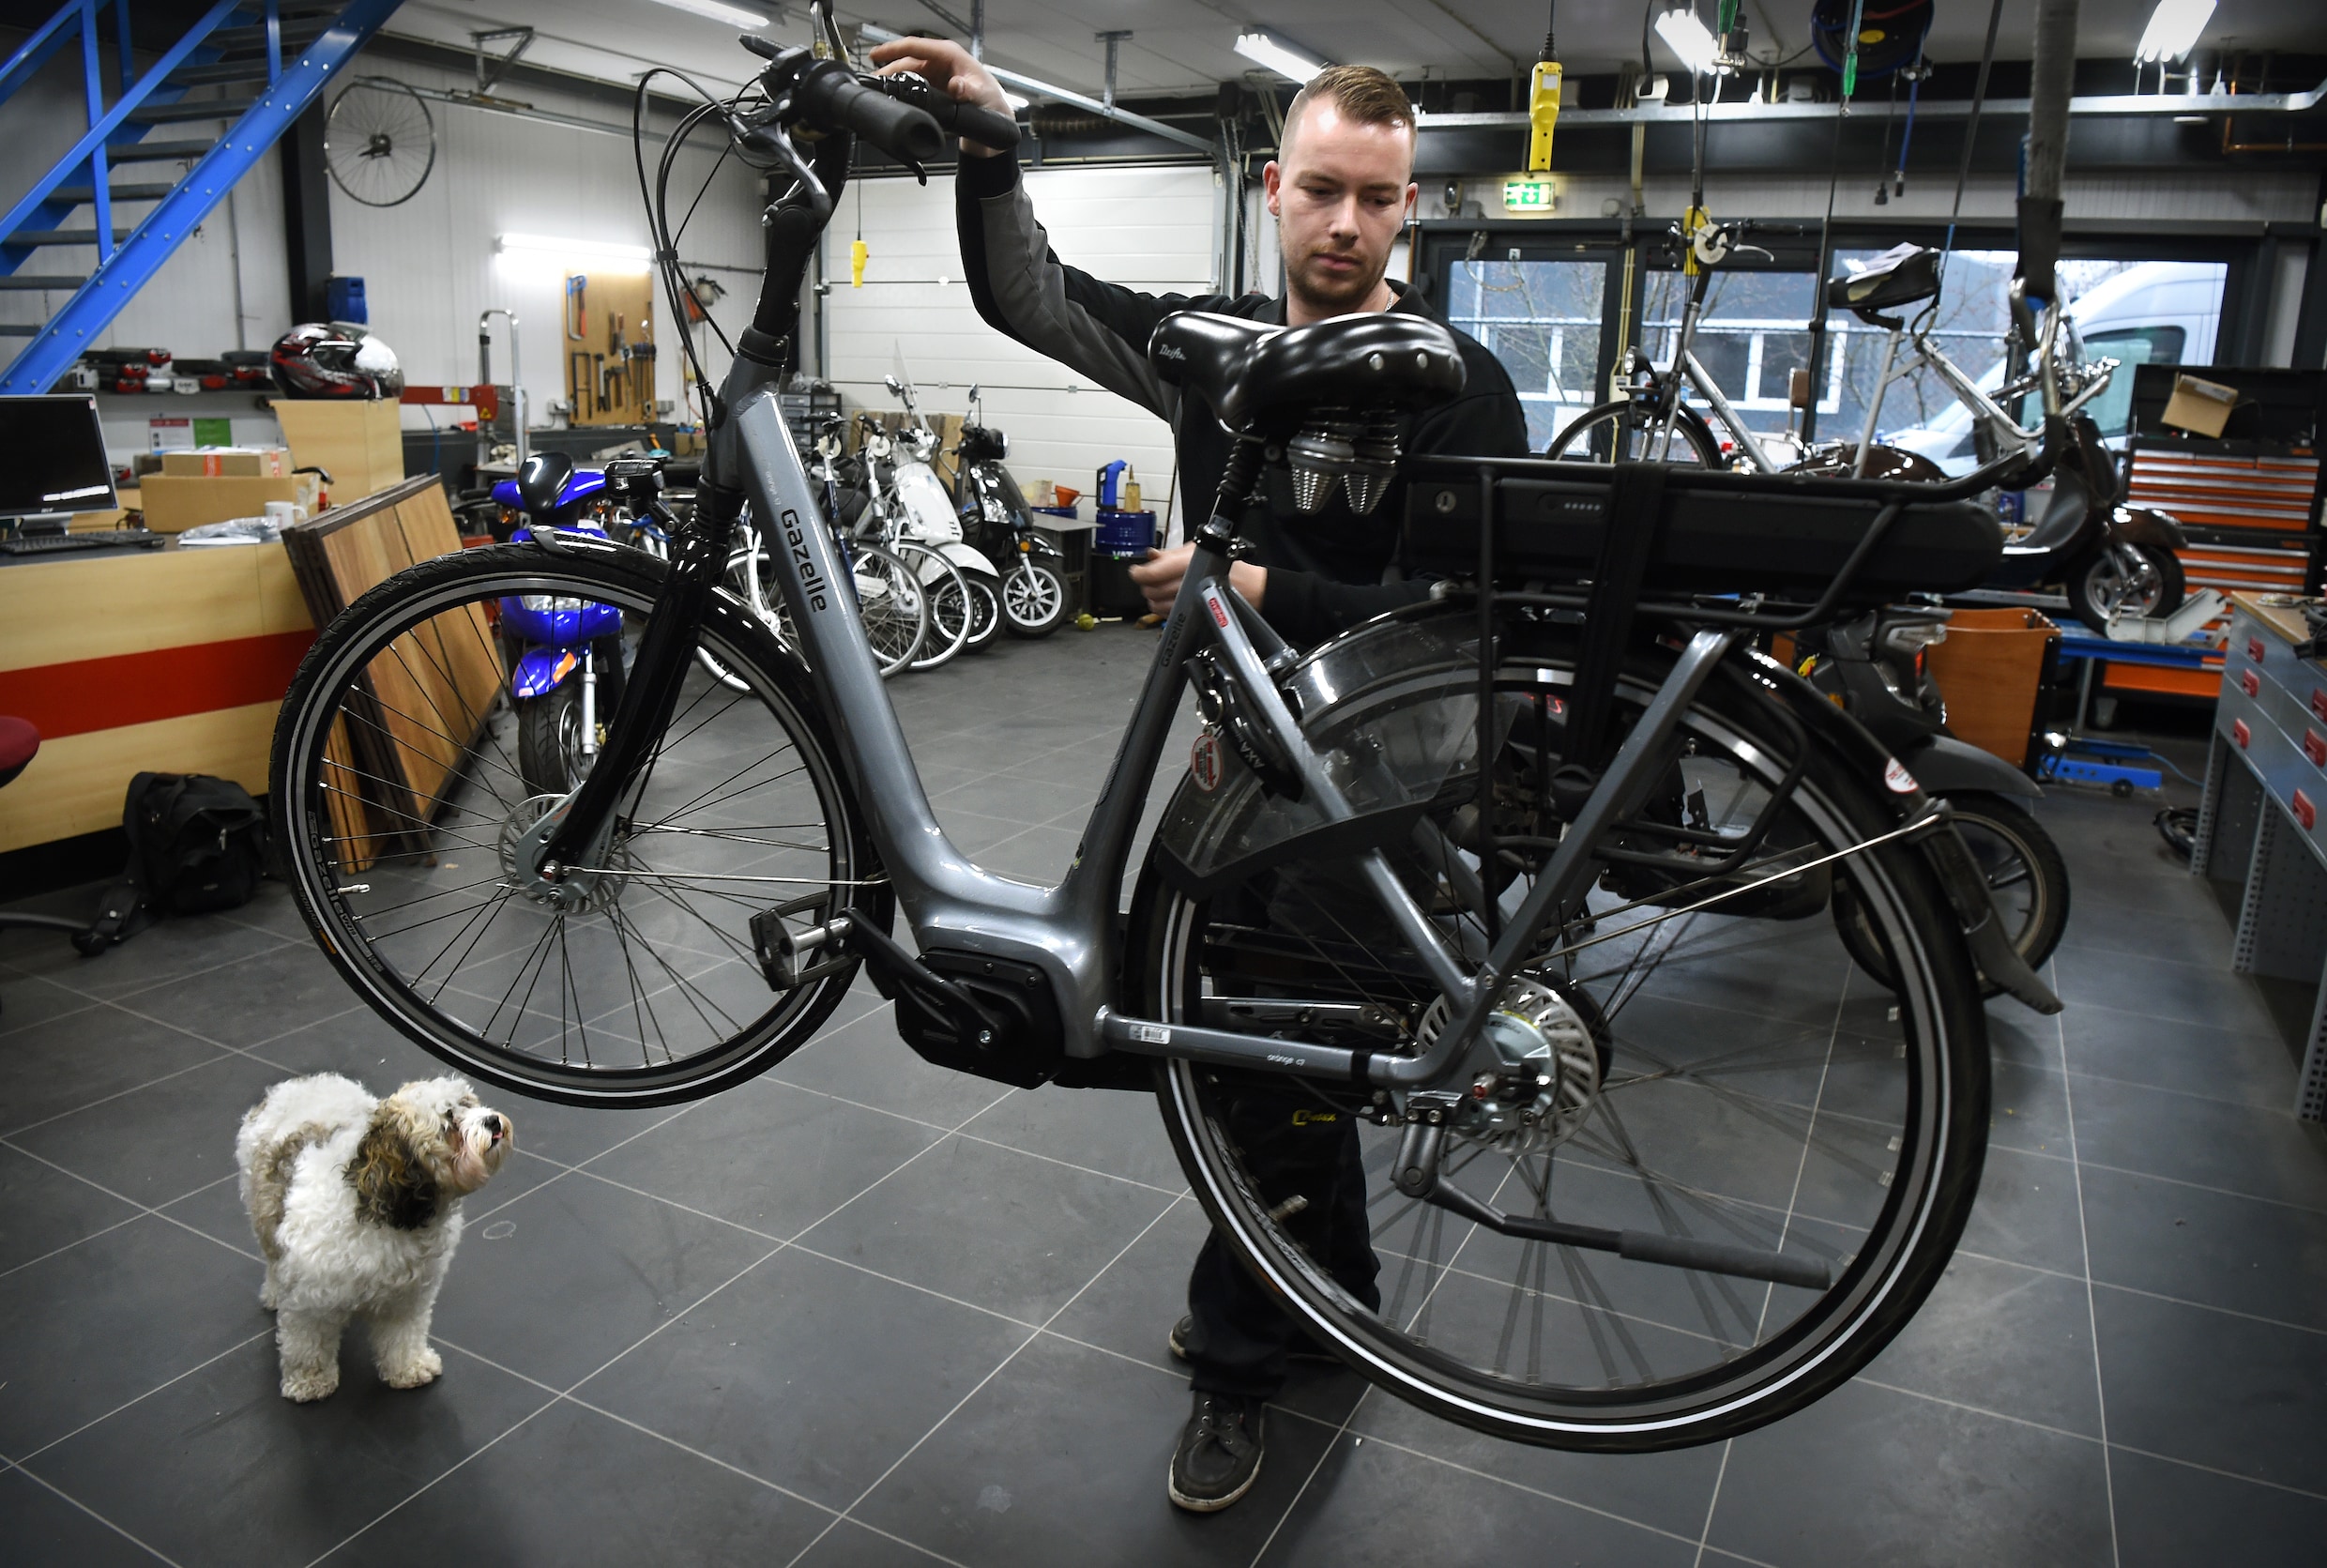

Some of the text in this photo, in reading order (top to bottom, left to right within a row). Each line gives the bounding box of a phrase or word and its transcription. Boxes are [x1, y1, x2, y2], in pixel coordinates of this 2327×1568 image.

[781, 509, 828, 613] Gazelle
[1161, 612, 1187, 667] Gazelle
[1240, 740, 1266, 769] AXA
[310, 833, 345, 916] Gazelle
